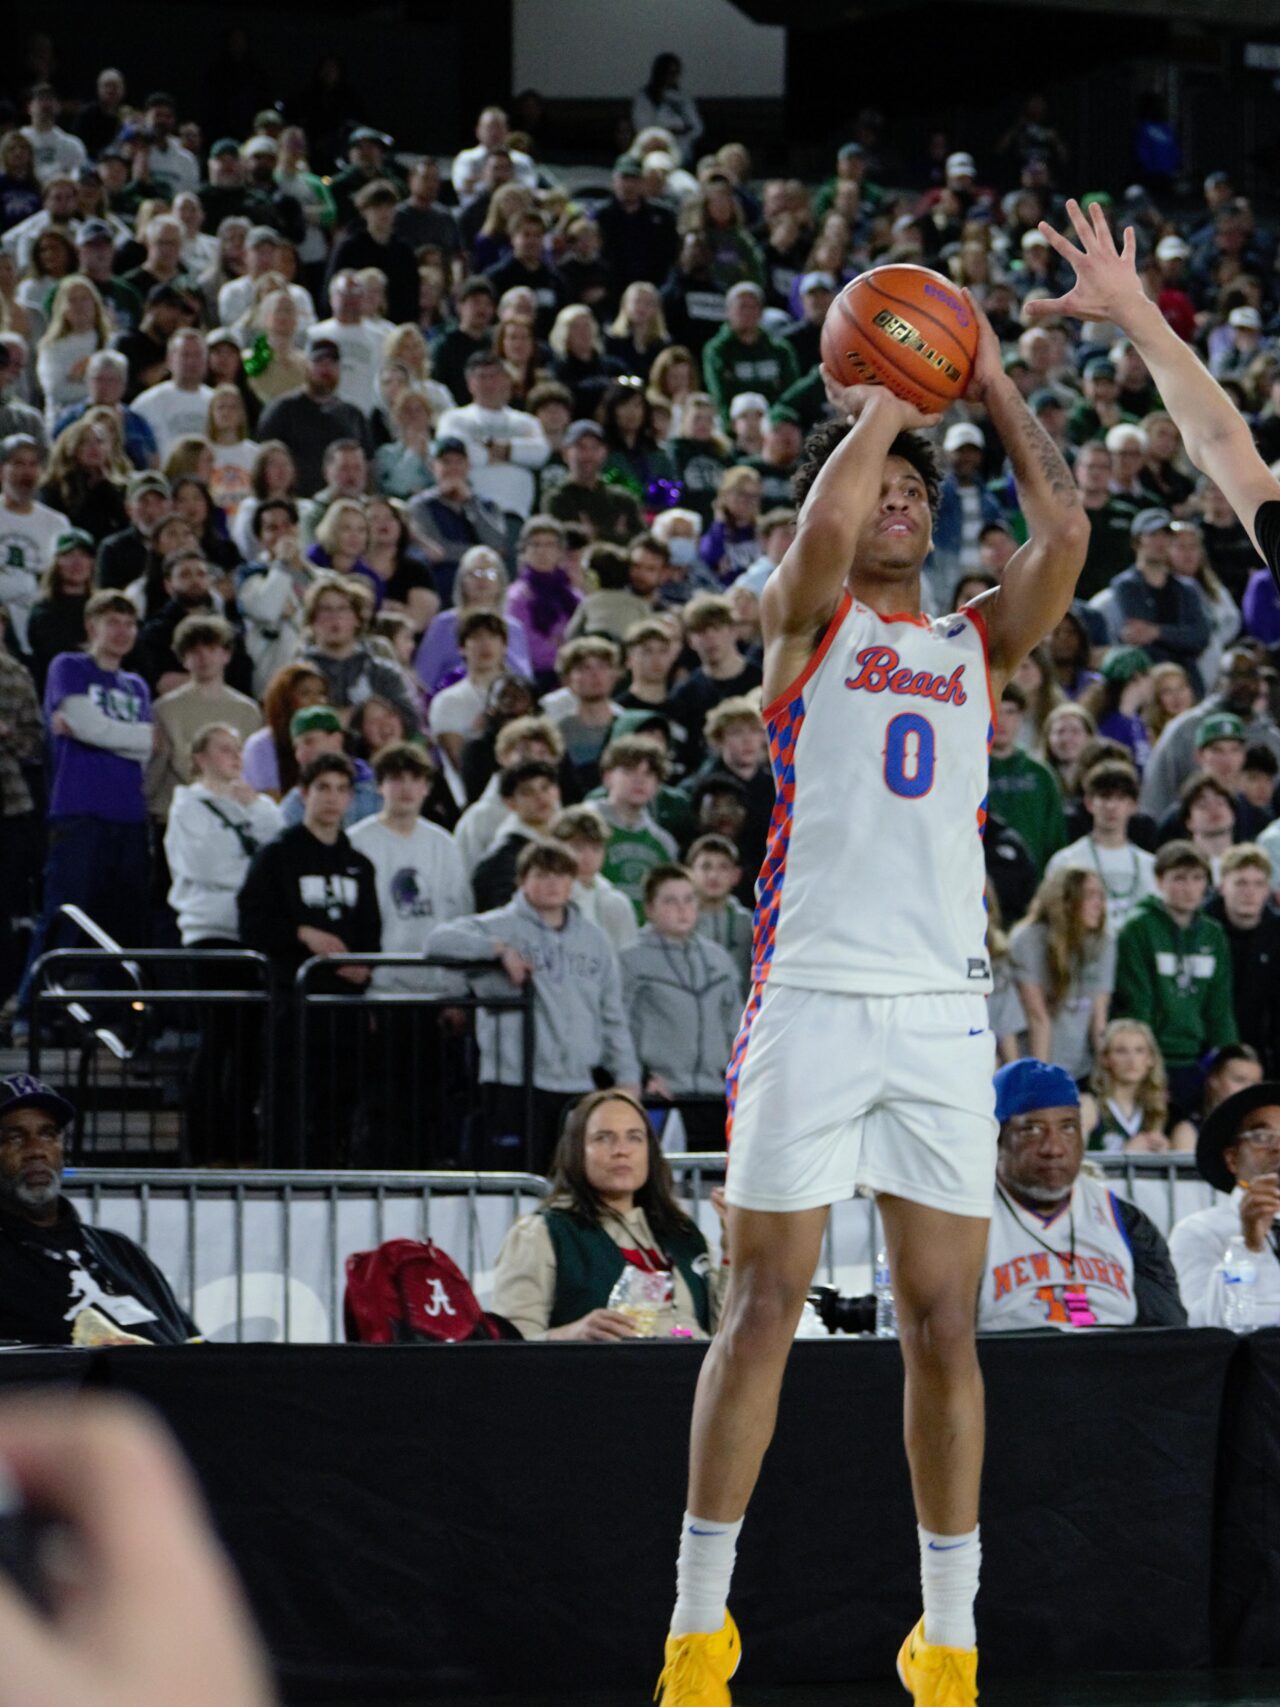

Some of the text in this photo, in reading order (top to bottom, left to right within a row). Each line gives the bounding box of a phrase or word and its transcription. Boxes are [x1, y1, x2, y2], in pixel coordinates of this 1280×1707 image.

[845, 645, 968, 707] Beach
[882, 711, 936, 799] 0
[424, 1278, 457, 1317] A
[992, 1250, 1131, 1302] NEW YORK
